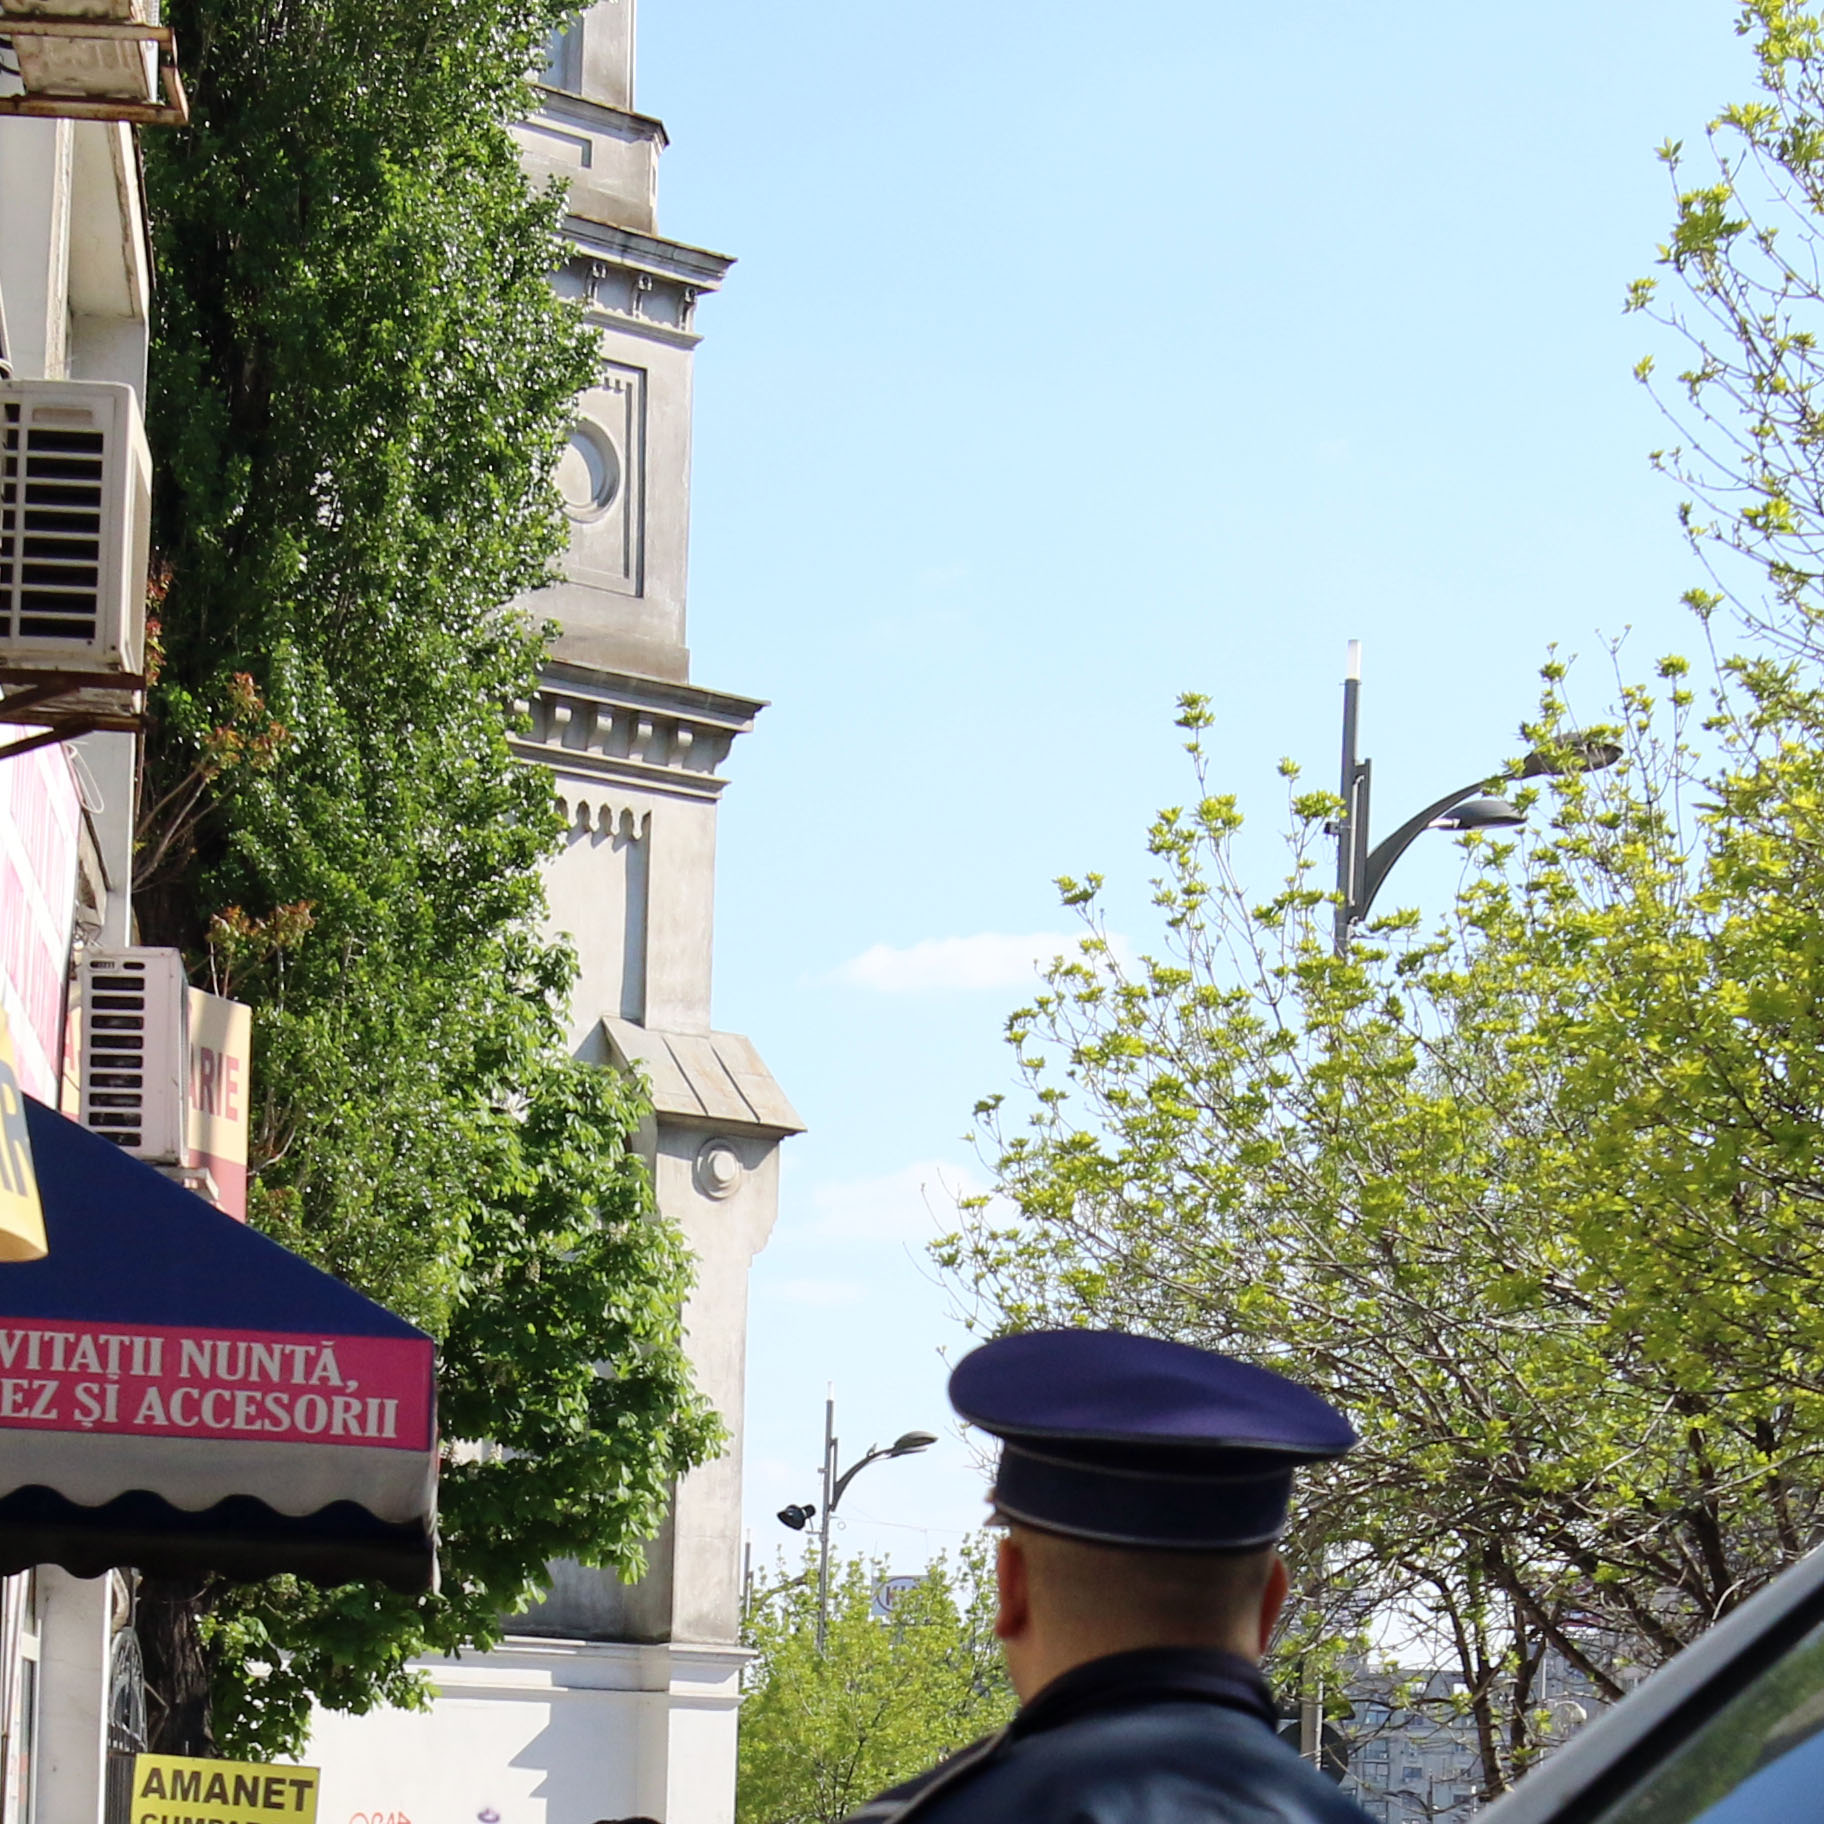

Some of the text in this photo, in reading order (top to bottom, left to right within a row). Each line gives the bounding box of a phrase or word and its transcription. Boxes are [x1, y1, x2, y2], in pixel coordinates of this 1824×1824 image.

[179, 1338, 359, 1392] NUNTĂ,
[134, 1386, 399, 1439] ACCESORII
[141, 1767, 314, 1812] AMANET
